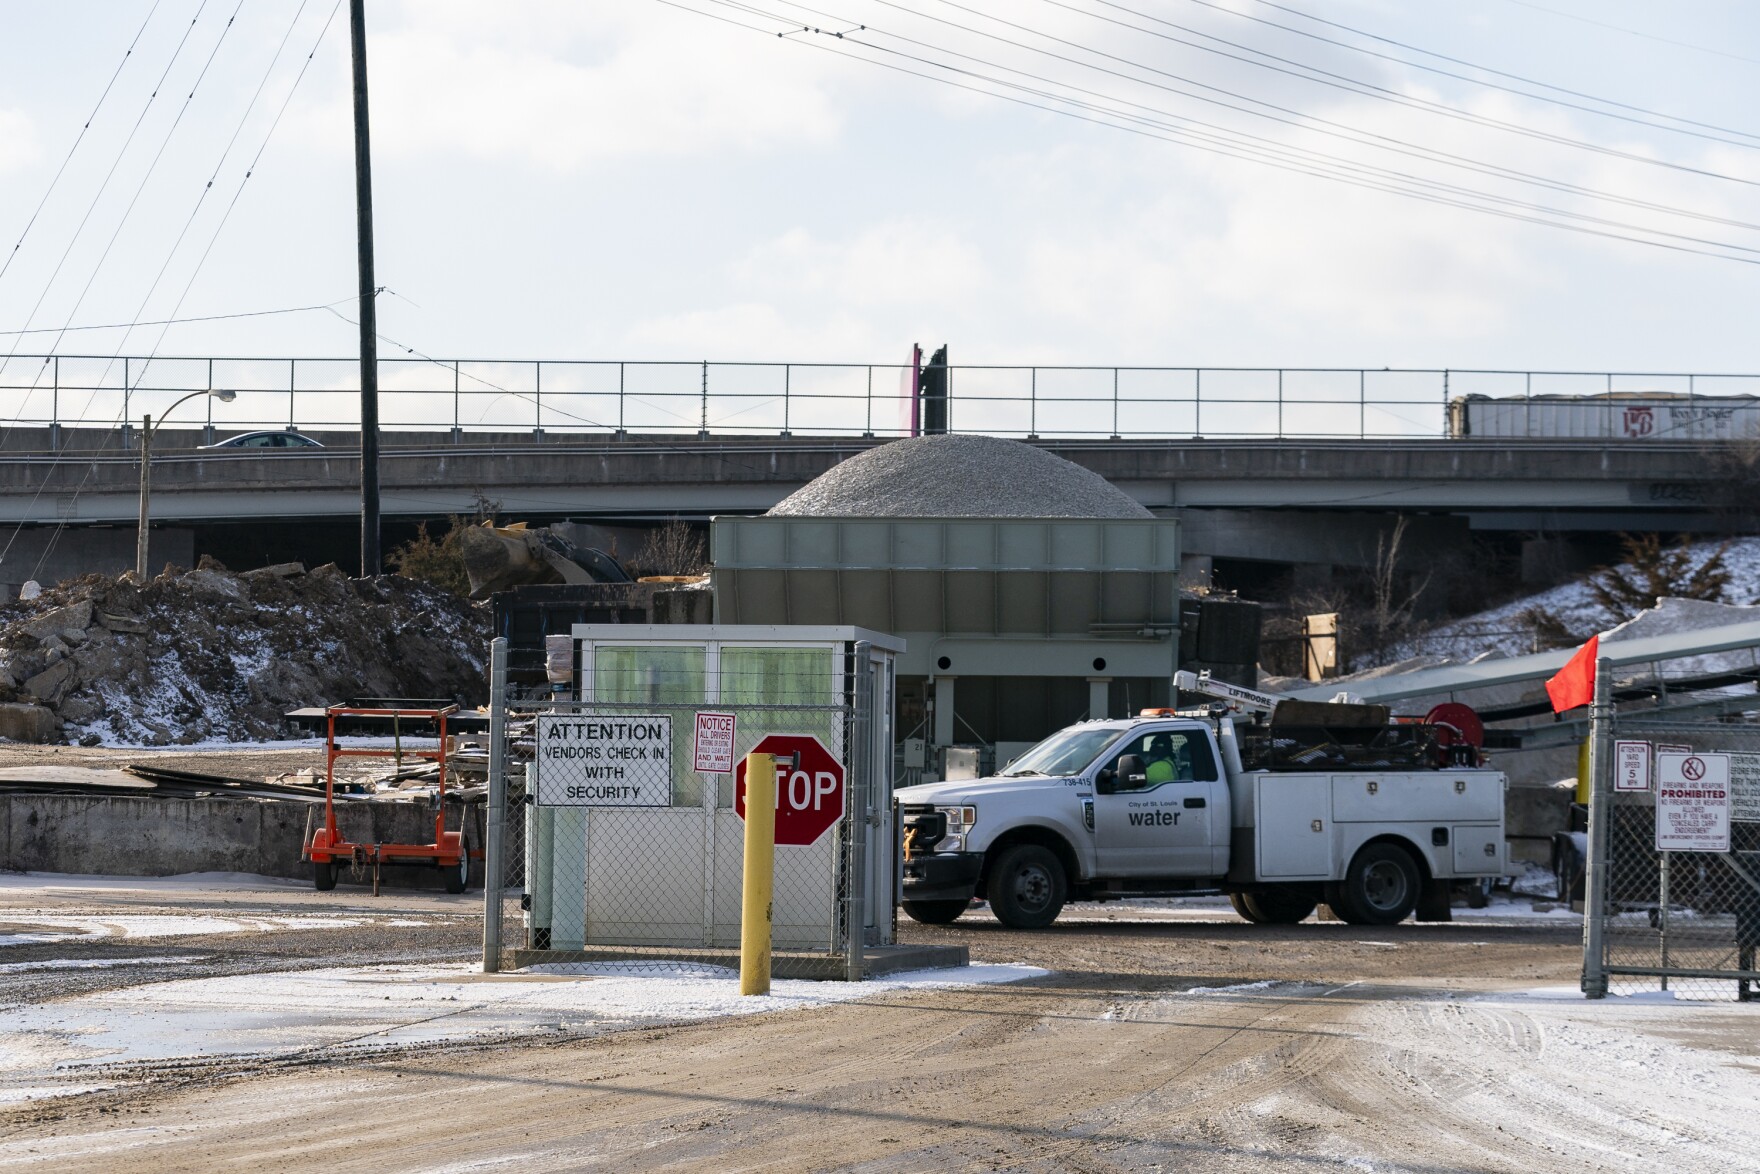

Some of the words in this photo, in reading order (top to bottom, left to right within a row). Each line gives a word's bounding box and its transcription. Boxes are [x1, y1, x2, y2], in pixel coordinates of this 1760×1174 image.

[1228, 688, 1272, 706] LIFTMOORE
[700, 717, 732, 731] NOTICE
[547, 723, 662, 740] ATTENTION
[700, 730, 709, 739] ALL
[710, 730, 731, 740] DRIVERS
[545, 746, 601, 759] VENDORS
[607, 746, 647, 760] CHECK
[653, 747, 664, 760] IN
[1620, 745, 1646, 753] ATTENTION
[1626, 753, 1640, 761] YARD
[1624, 761, 1641, 769] SPEED
[585, 766, 624, 779] WITH
[1628, 769, 1636, 779] 5
[1062, 777, 1091, 787] 738-415
[1662, 781, 1687, 789] FIREARMS
[1701, 782, 1725, 790] WEAPONS
[566, 786, 641, 799] SECURITY
[742, 770, 837, 811] TOP
[1661, 789, 1727, 799] PROHIBITED
[1661, 798, 1669, 806] NO
[1669, 798, 1693, 806] FIREARMS
[1694, 799, 1702, 807] OR
[1703, 799, 1727, 807] WEAPONS
[1128, 809, 1181, 827] water
[1668, 812, 1681, 820] EVEN
[1690, 812, 1699, 820] YOU
[1700, 812, 1713, 820] HAVE
